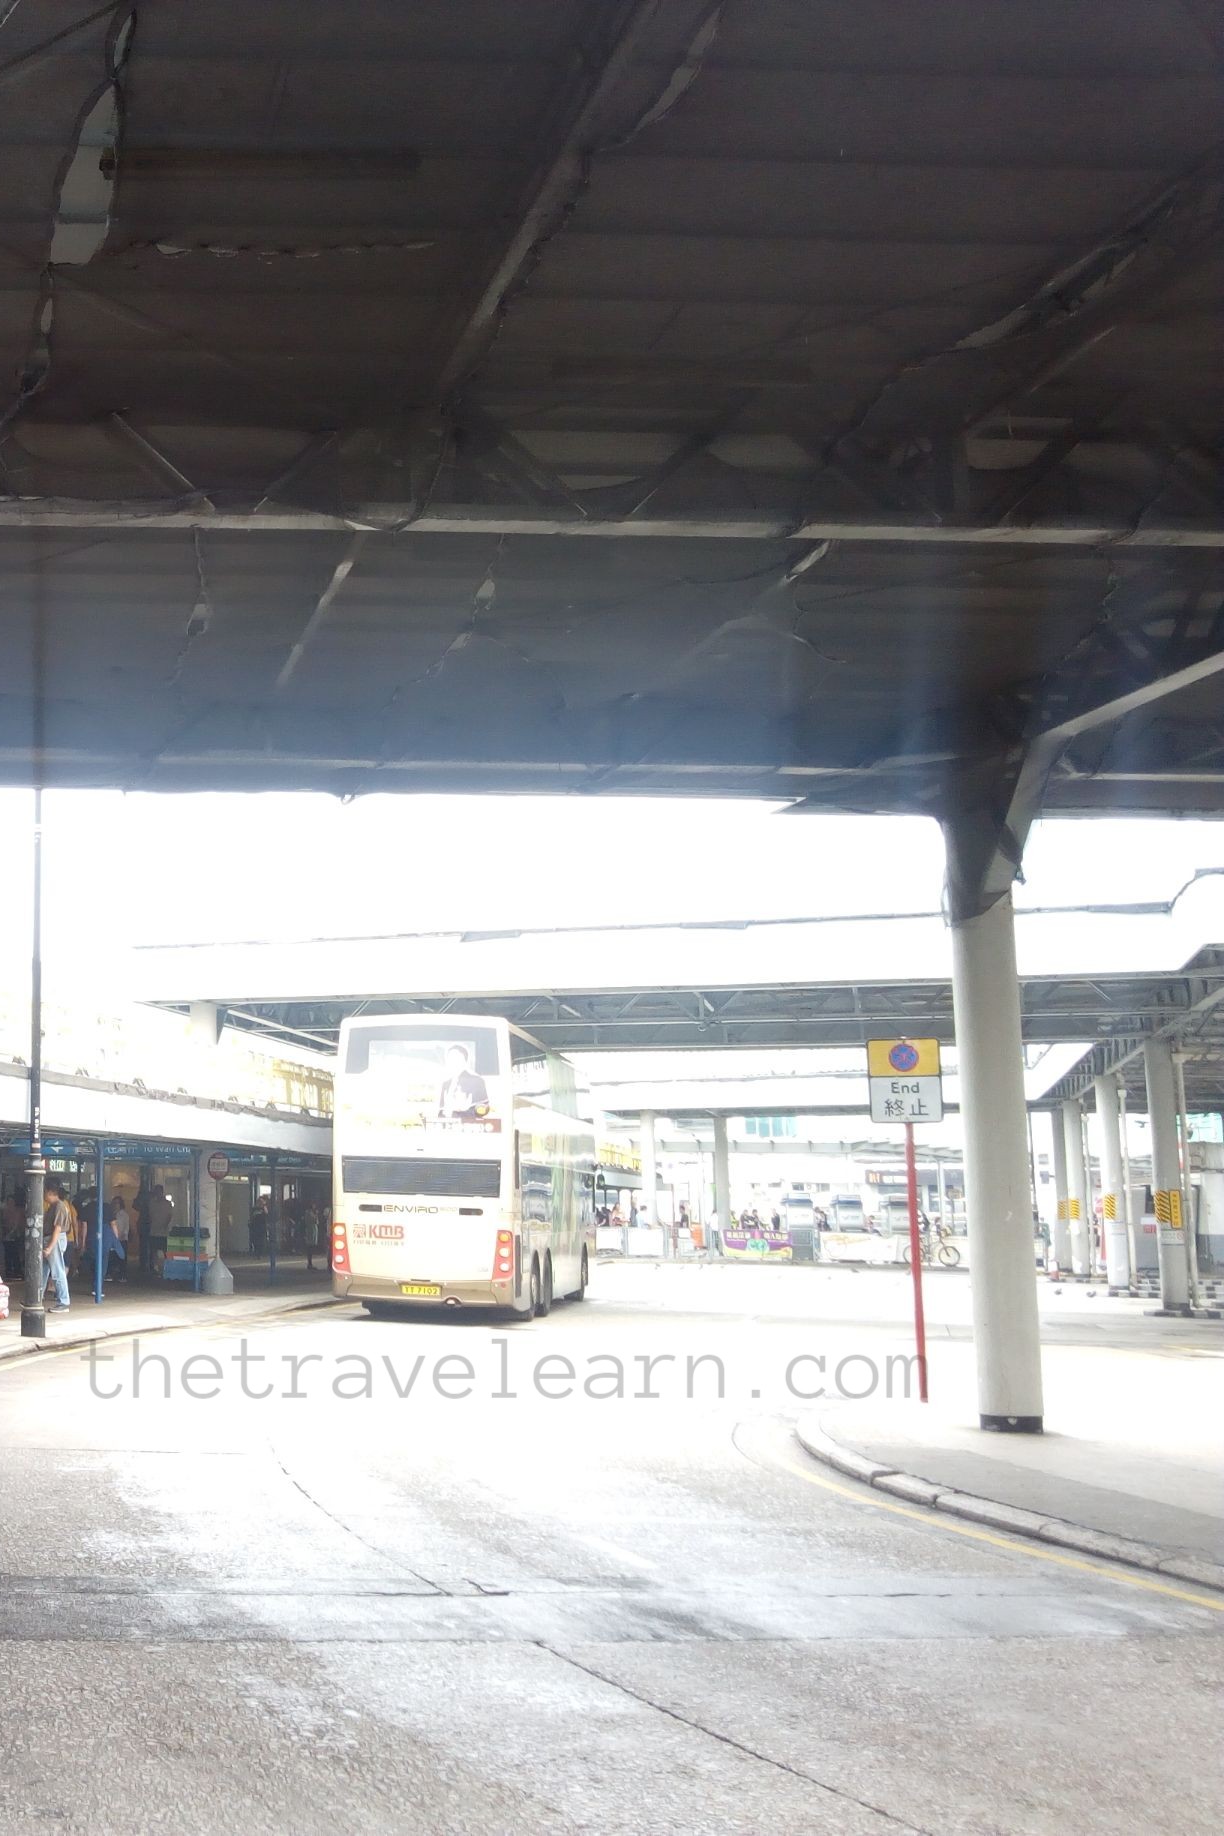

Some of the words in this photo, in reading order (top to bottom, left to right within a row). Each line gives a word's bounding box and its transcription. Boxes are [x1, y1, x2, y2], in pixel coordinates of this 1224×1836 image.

[891, 1081, 920, 1094] End
[884, 1098, 930, 1118] 終止
[369, 1225, 404, 1239] KMB
